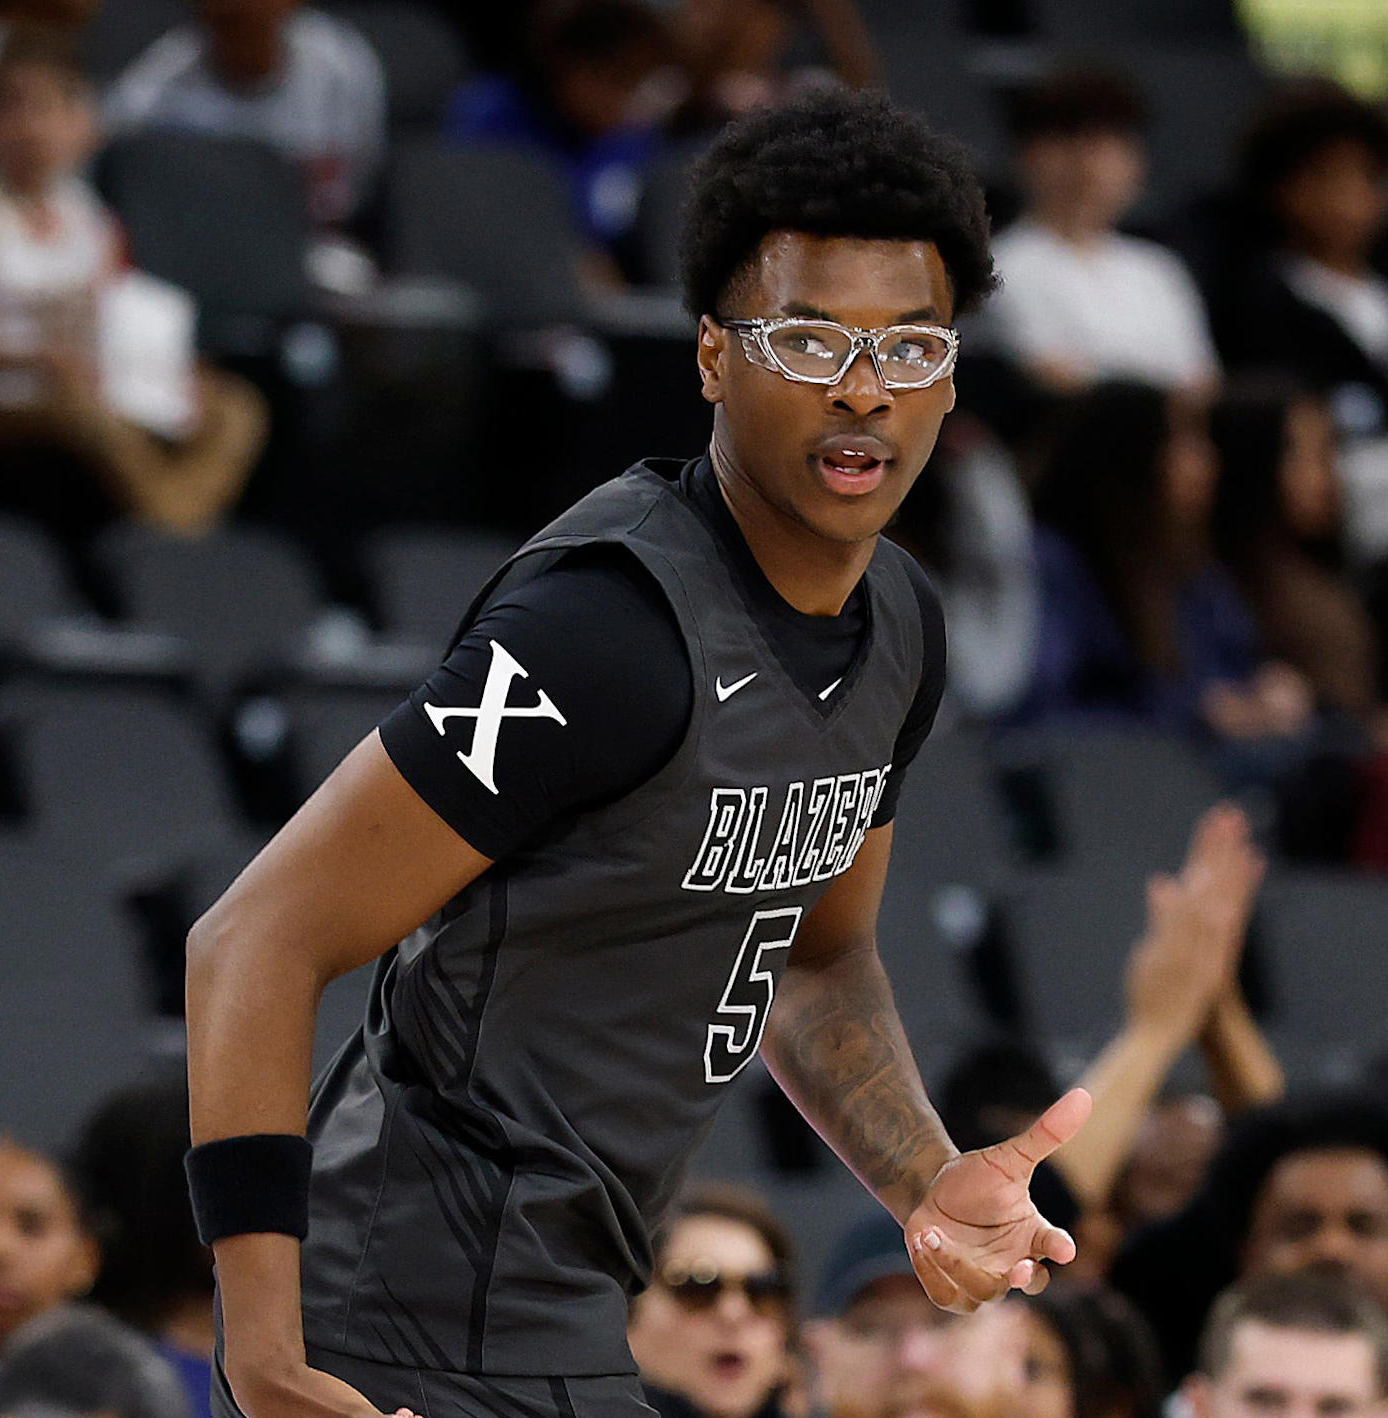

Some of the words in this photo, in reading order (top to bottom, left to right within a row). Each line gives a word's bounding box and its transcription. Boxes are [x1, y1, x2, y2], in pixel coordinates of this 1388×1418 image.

[423, 639, 567, 795] X
[681, 763, 892, 894] BLAZER
[703, 906, 803, 1083] 5
